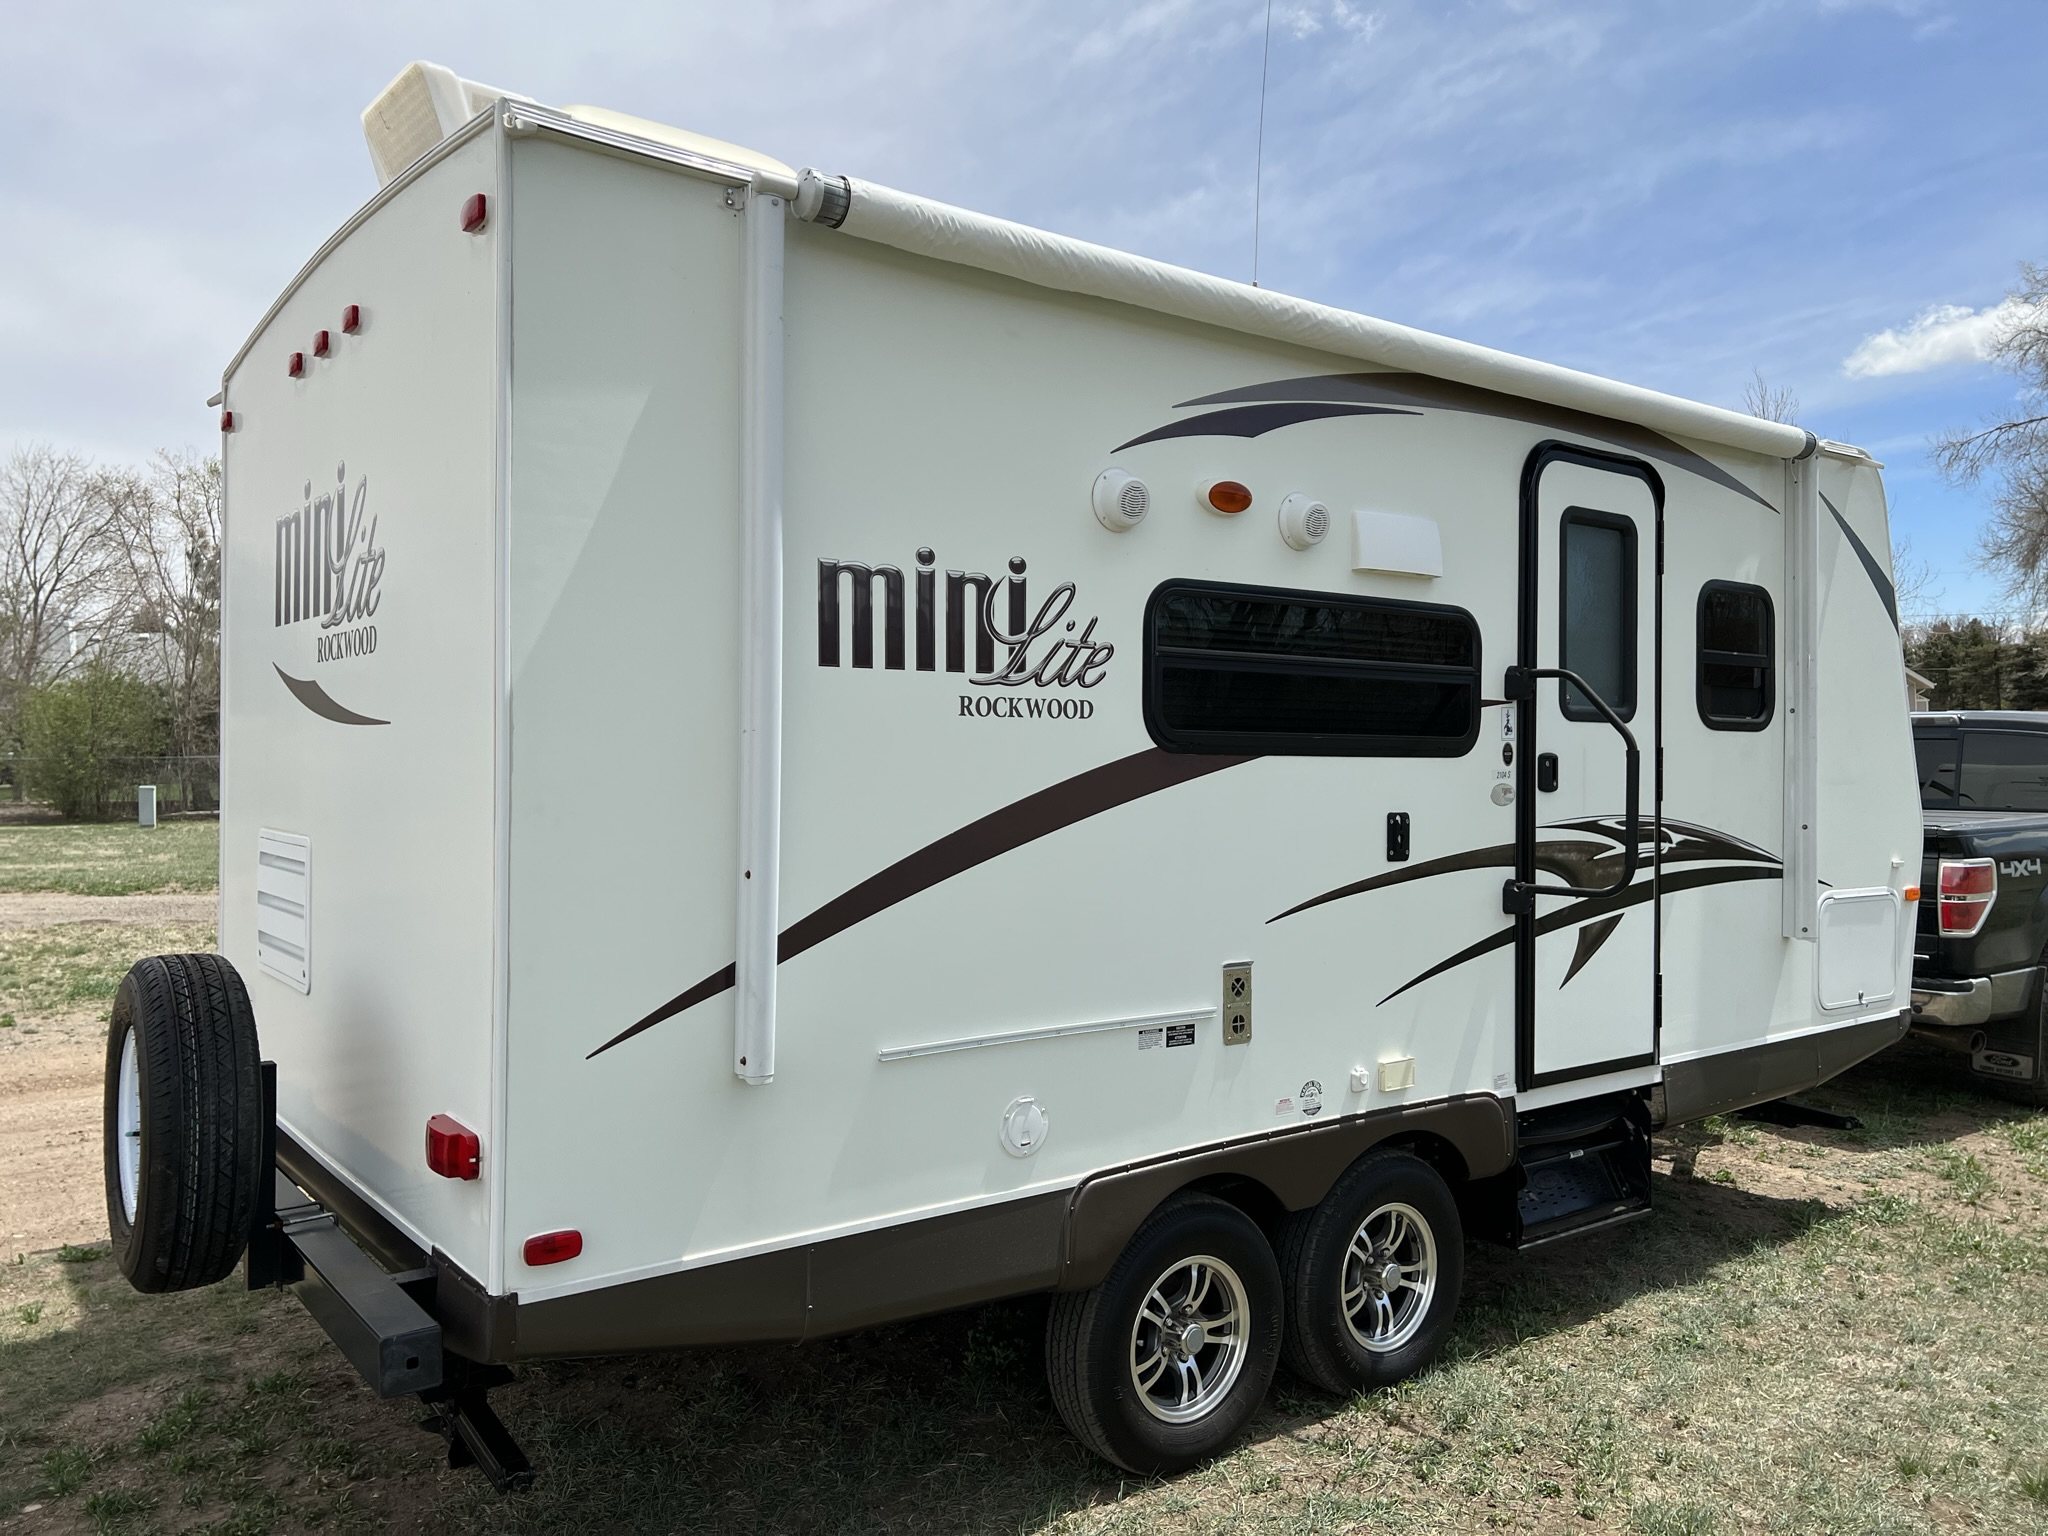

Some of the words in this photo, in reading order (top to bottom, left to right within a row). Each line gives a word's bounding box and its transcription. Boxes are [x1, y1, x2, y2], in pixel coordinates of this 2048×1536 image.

[275, 459, 346, 627] mini
[316, 625, 378, 663] ROCKWOOD
[817, 546, 1027, 674] mini
[958, 695, 1094, 720] ROCKWOOD
